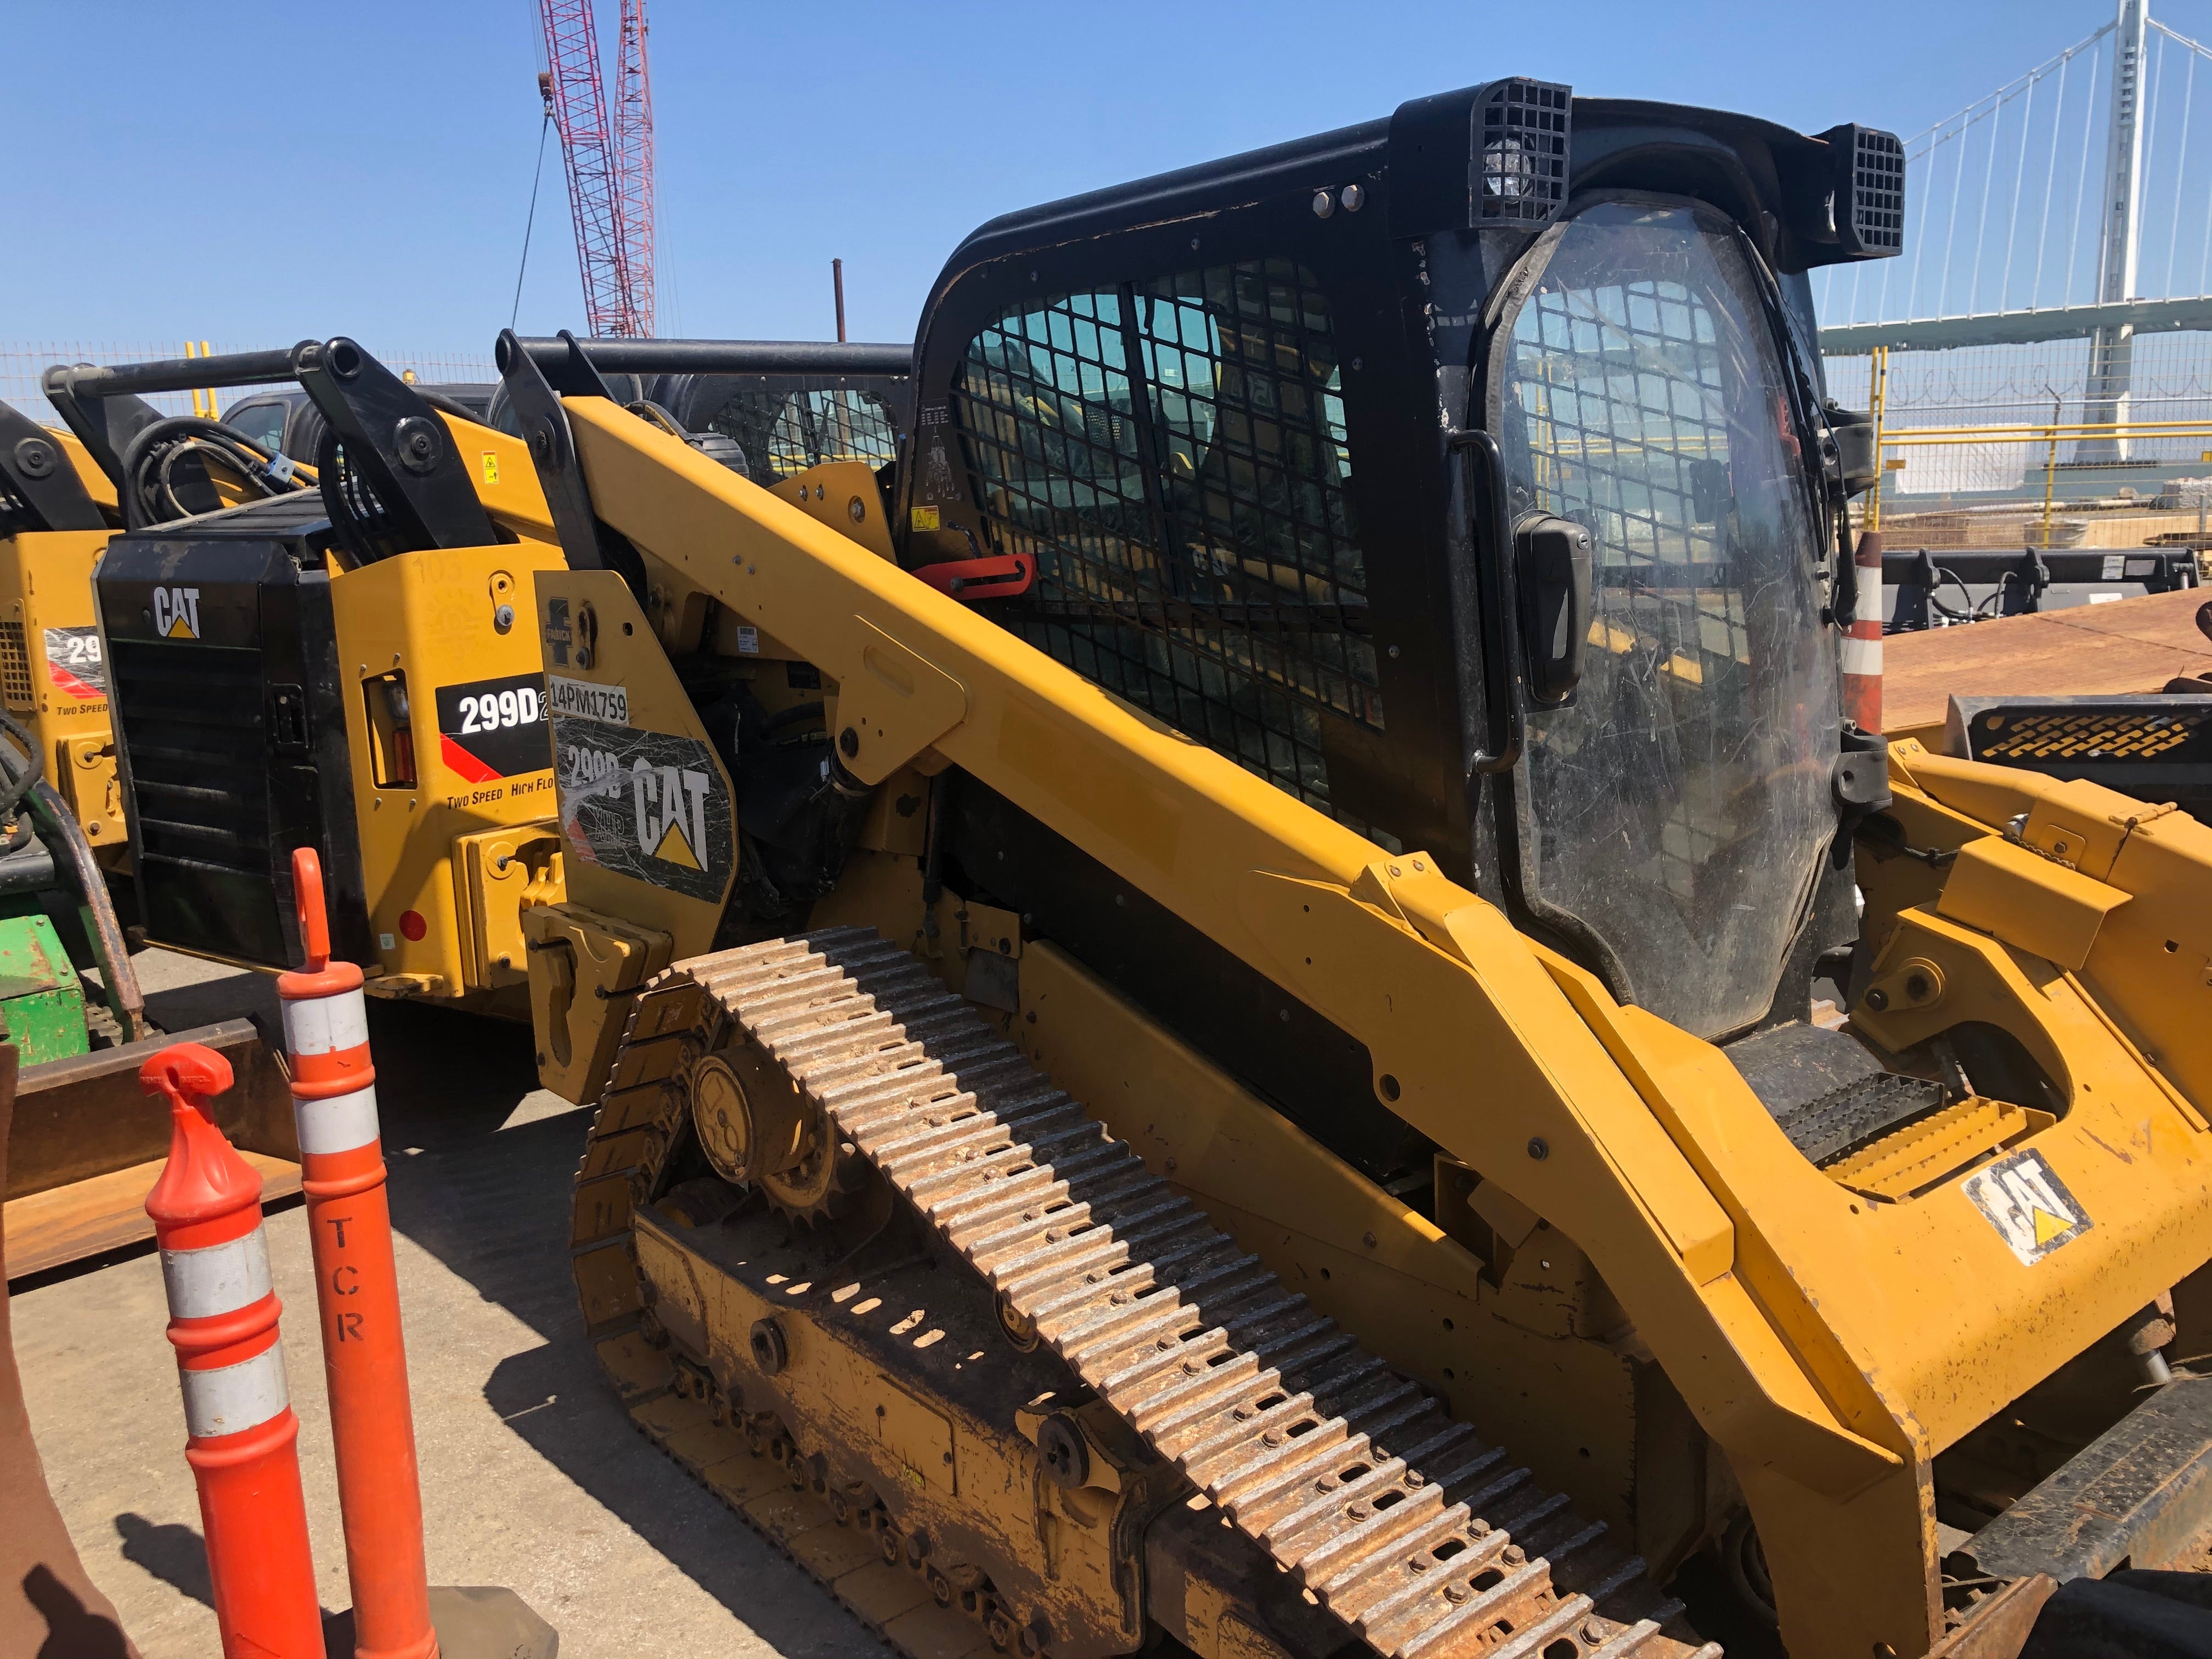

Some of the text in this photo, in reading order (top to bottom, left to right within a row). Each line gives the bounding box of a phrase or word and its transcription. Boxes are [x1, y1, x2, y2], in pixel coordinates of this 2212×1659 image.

[154, 586, 200, 639] CAT
[57, 703, 109, 715] TWO SPEED
[550, 682, 627, 721] 14PM1759
[447, 796, 469, 810] TWO
[472, 788, 503, 805] SPEED
[633, 755, 710, 872] CAT
[1978, 1158, 2078, 1251] CAT
